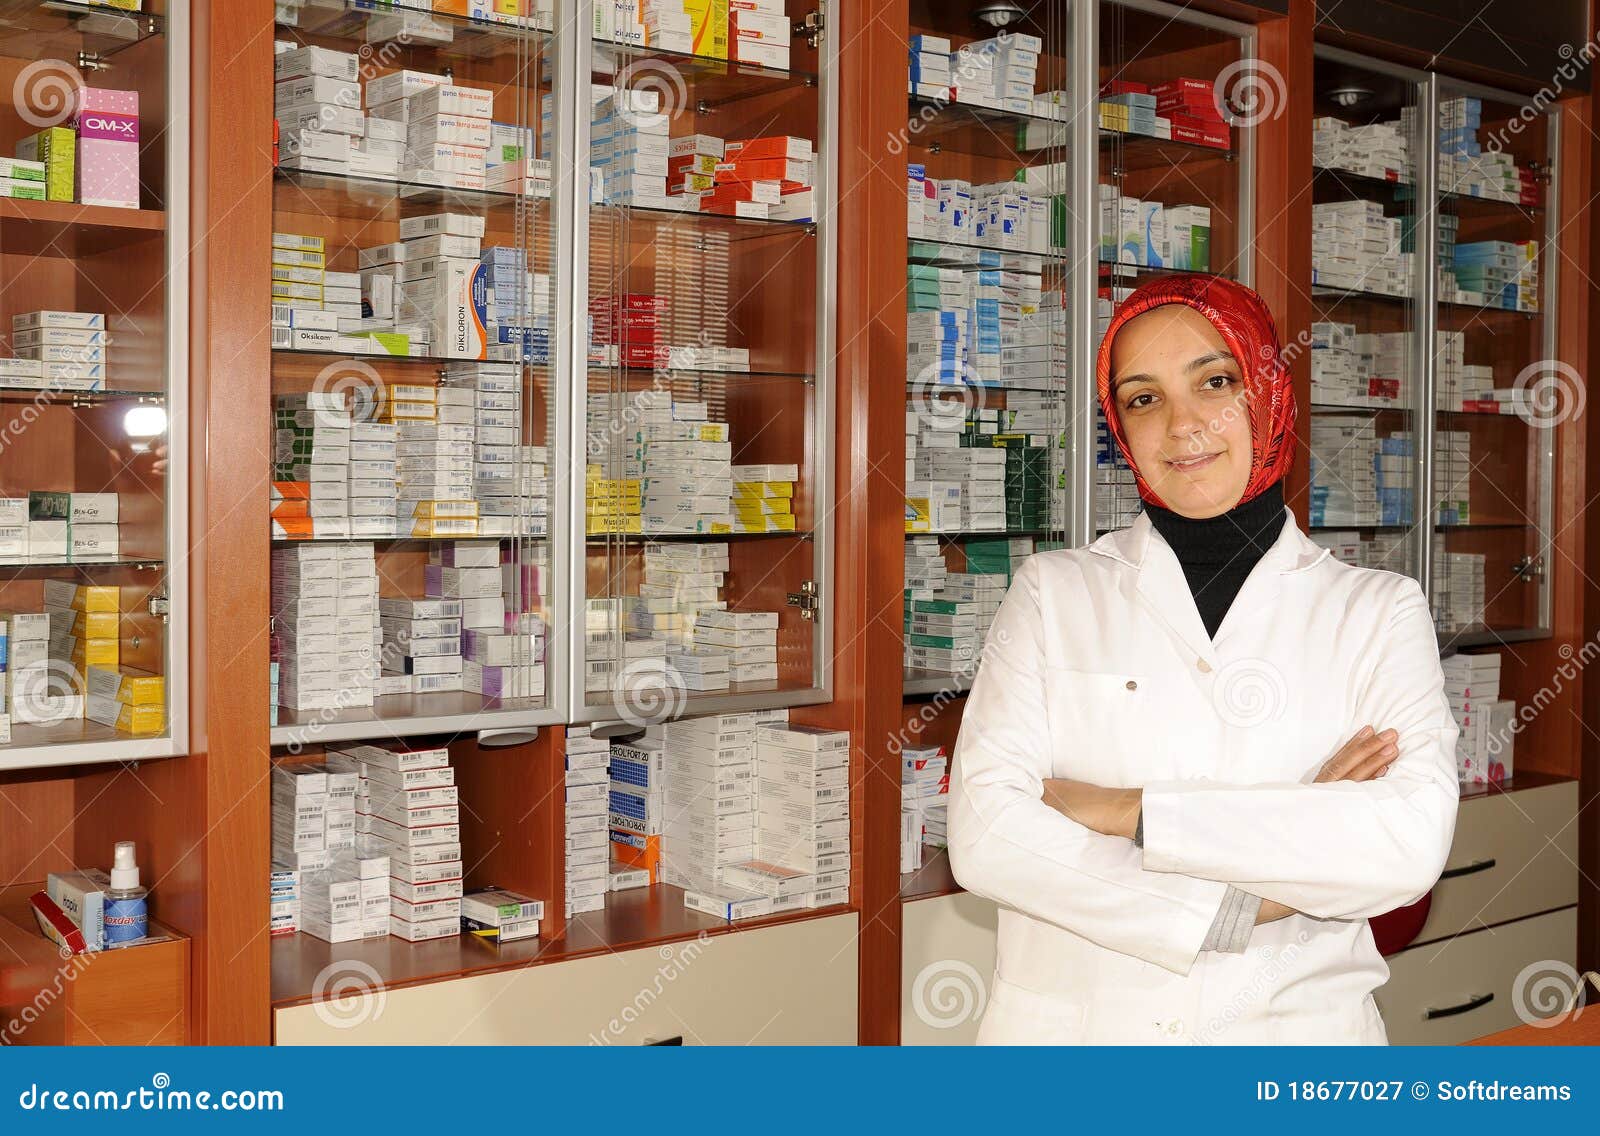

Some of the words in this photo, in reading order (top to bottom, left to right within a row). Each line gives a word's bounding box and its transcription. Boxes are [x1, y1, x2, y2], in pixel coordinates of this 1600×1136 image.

[85, 117, 135, 134] OM-X
[301, 332, 332, 341] Oksikam
[641, 752, 649, 762] 20
